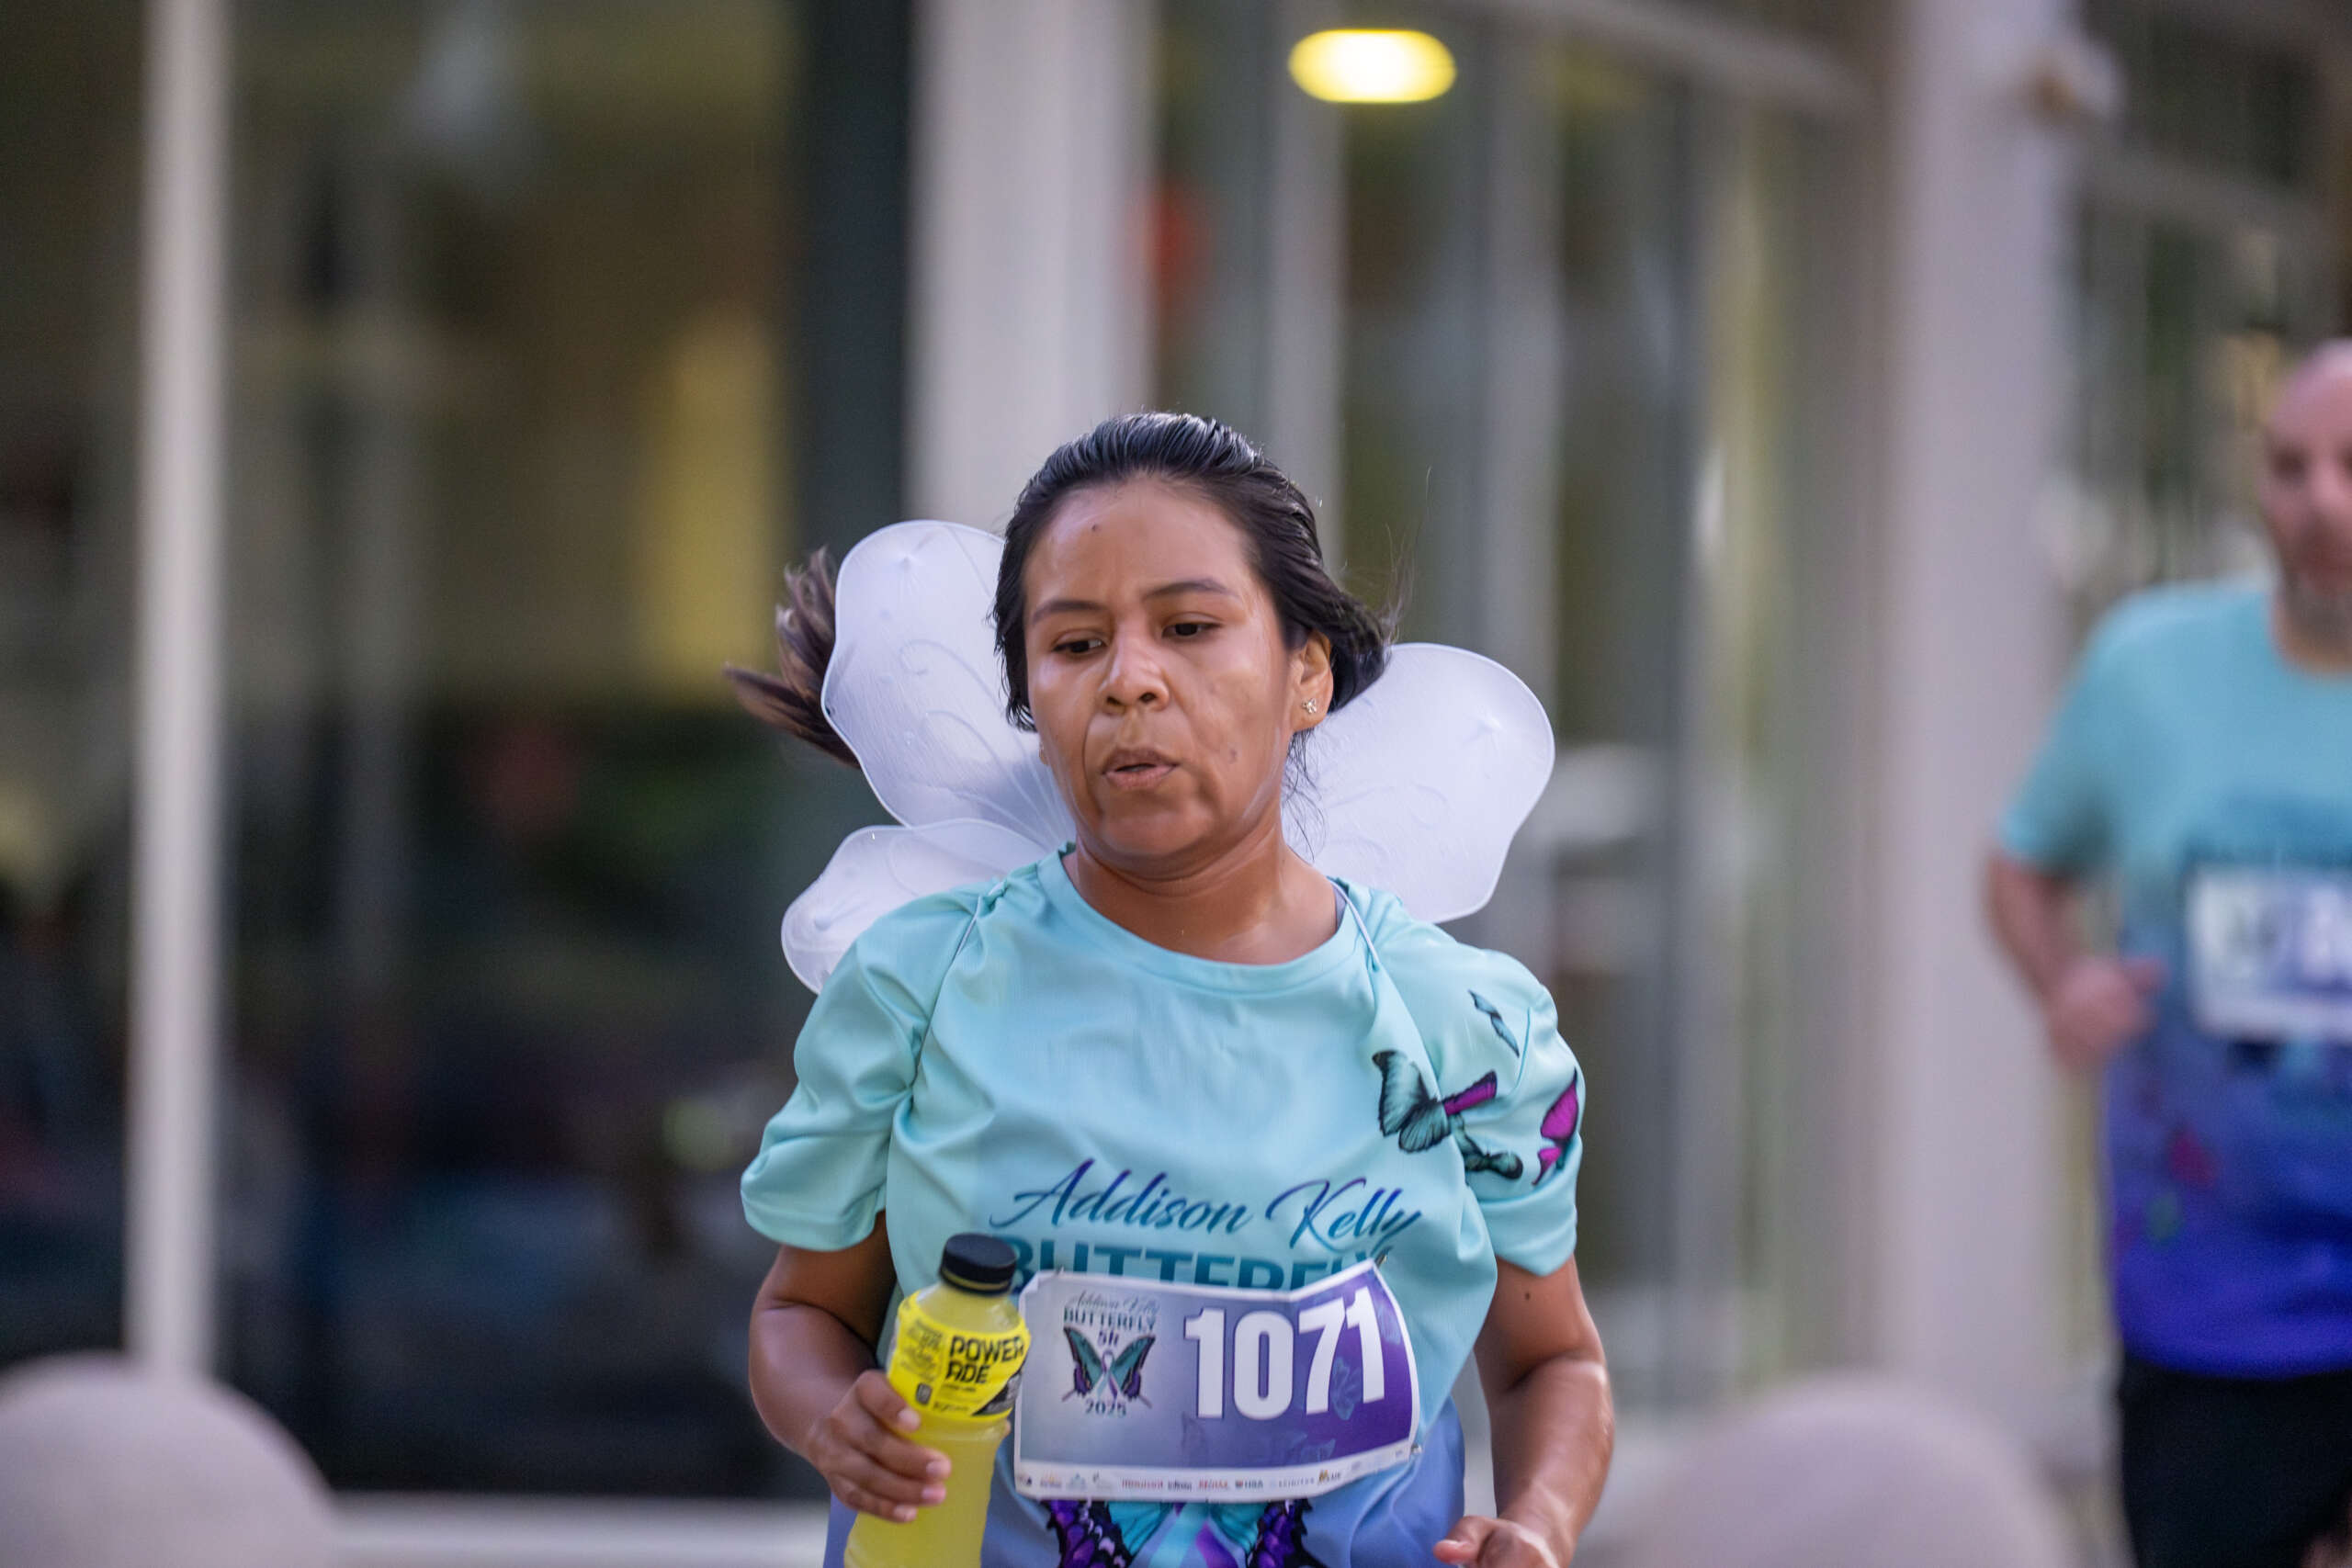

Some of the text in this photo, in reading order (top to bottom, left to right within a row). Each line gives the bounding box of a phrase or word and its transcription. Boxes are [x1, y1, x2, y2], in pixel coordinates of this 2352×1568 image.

[989, 1158, 1421, 1258] Addison Kelly
[950, 1335, 1025, 1363] POWER
[1184, 1286, 1385, 1421] 1071
[945, 1360, 991, 1384] ADE
[1085, 1397, 1126, 1416] 2025
